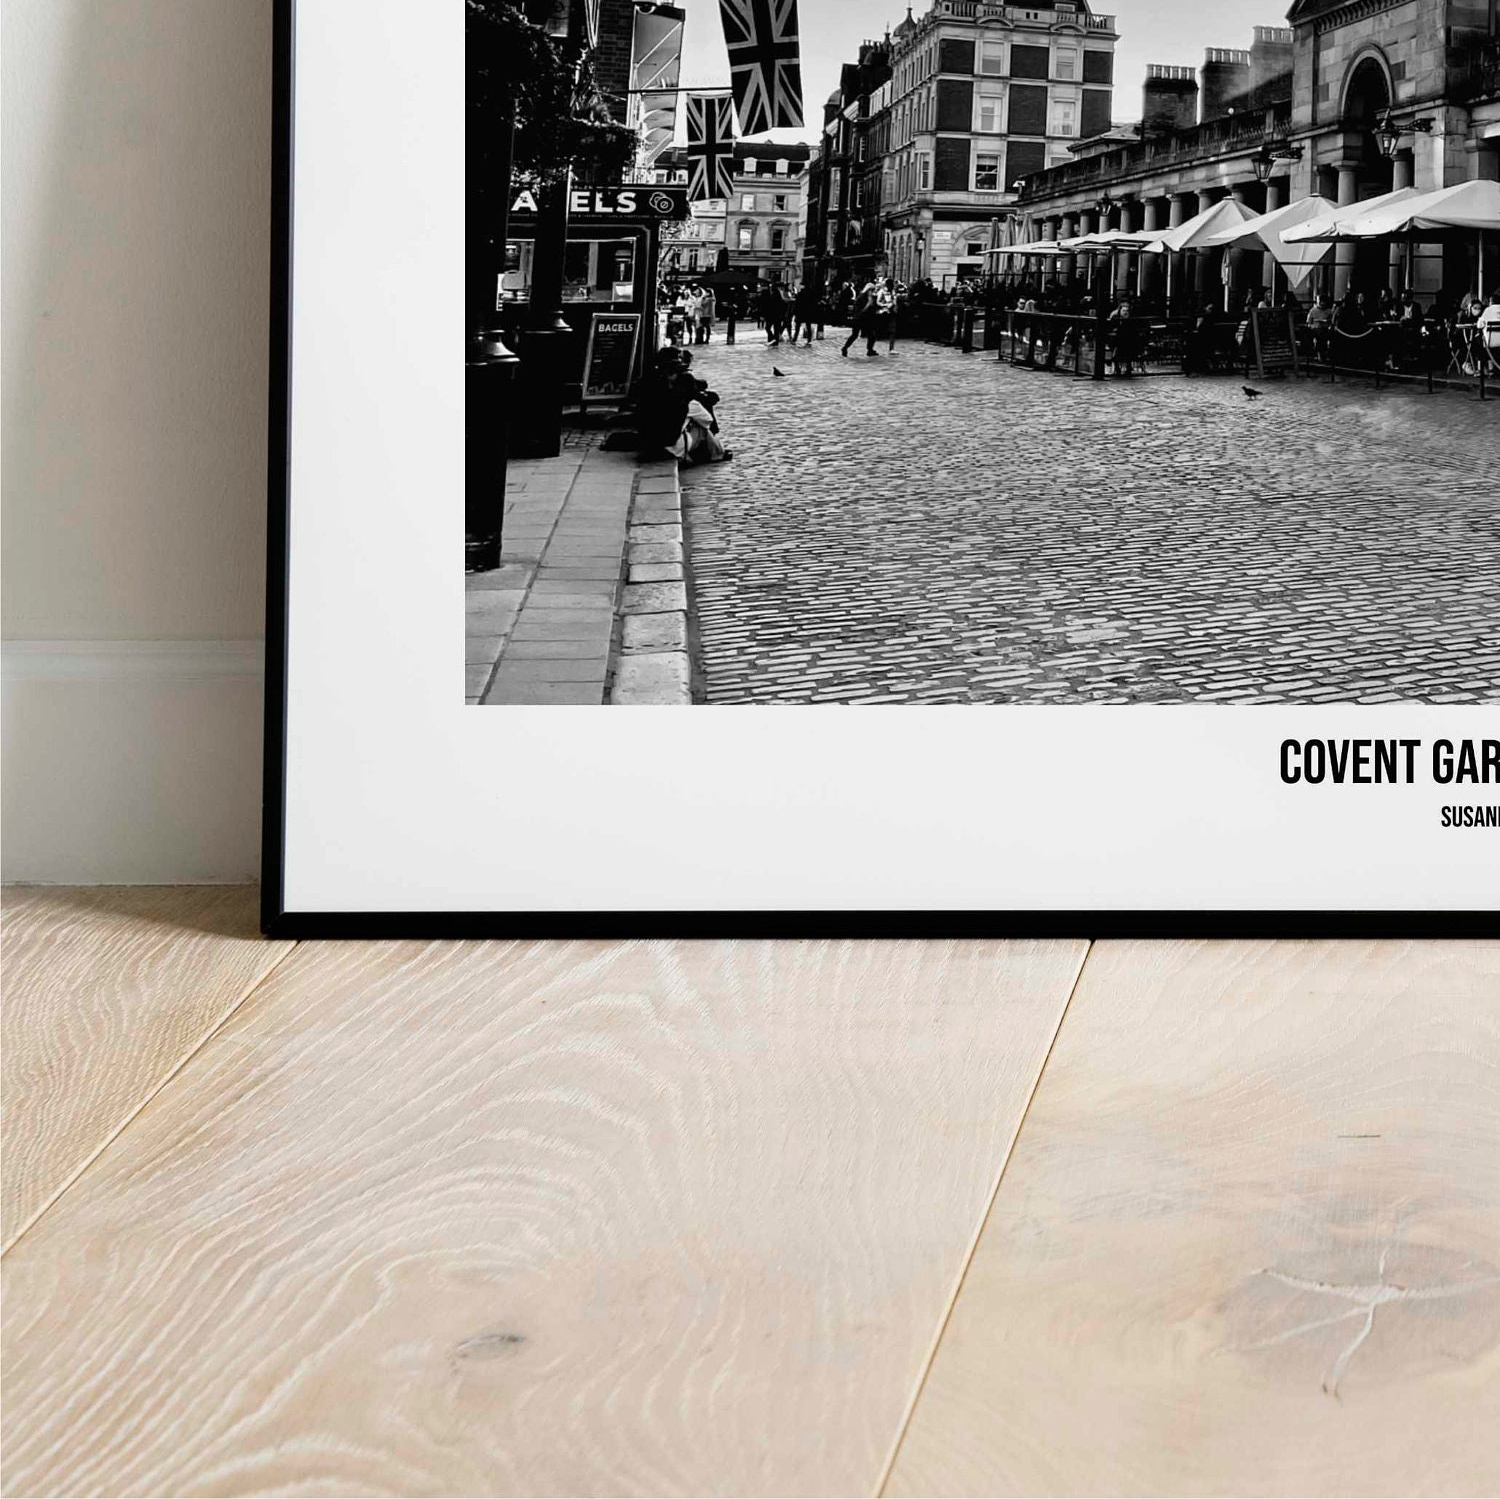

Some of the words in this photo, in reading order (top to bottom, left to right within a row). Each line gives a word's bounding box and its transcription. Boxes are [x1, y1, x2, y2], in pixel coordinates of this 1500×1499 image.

[510, 190, 638, 213] AELS
[598, 323, 634, 332] BAGELS
[1280, 738, 1422, 785] COVENT
